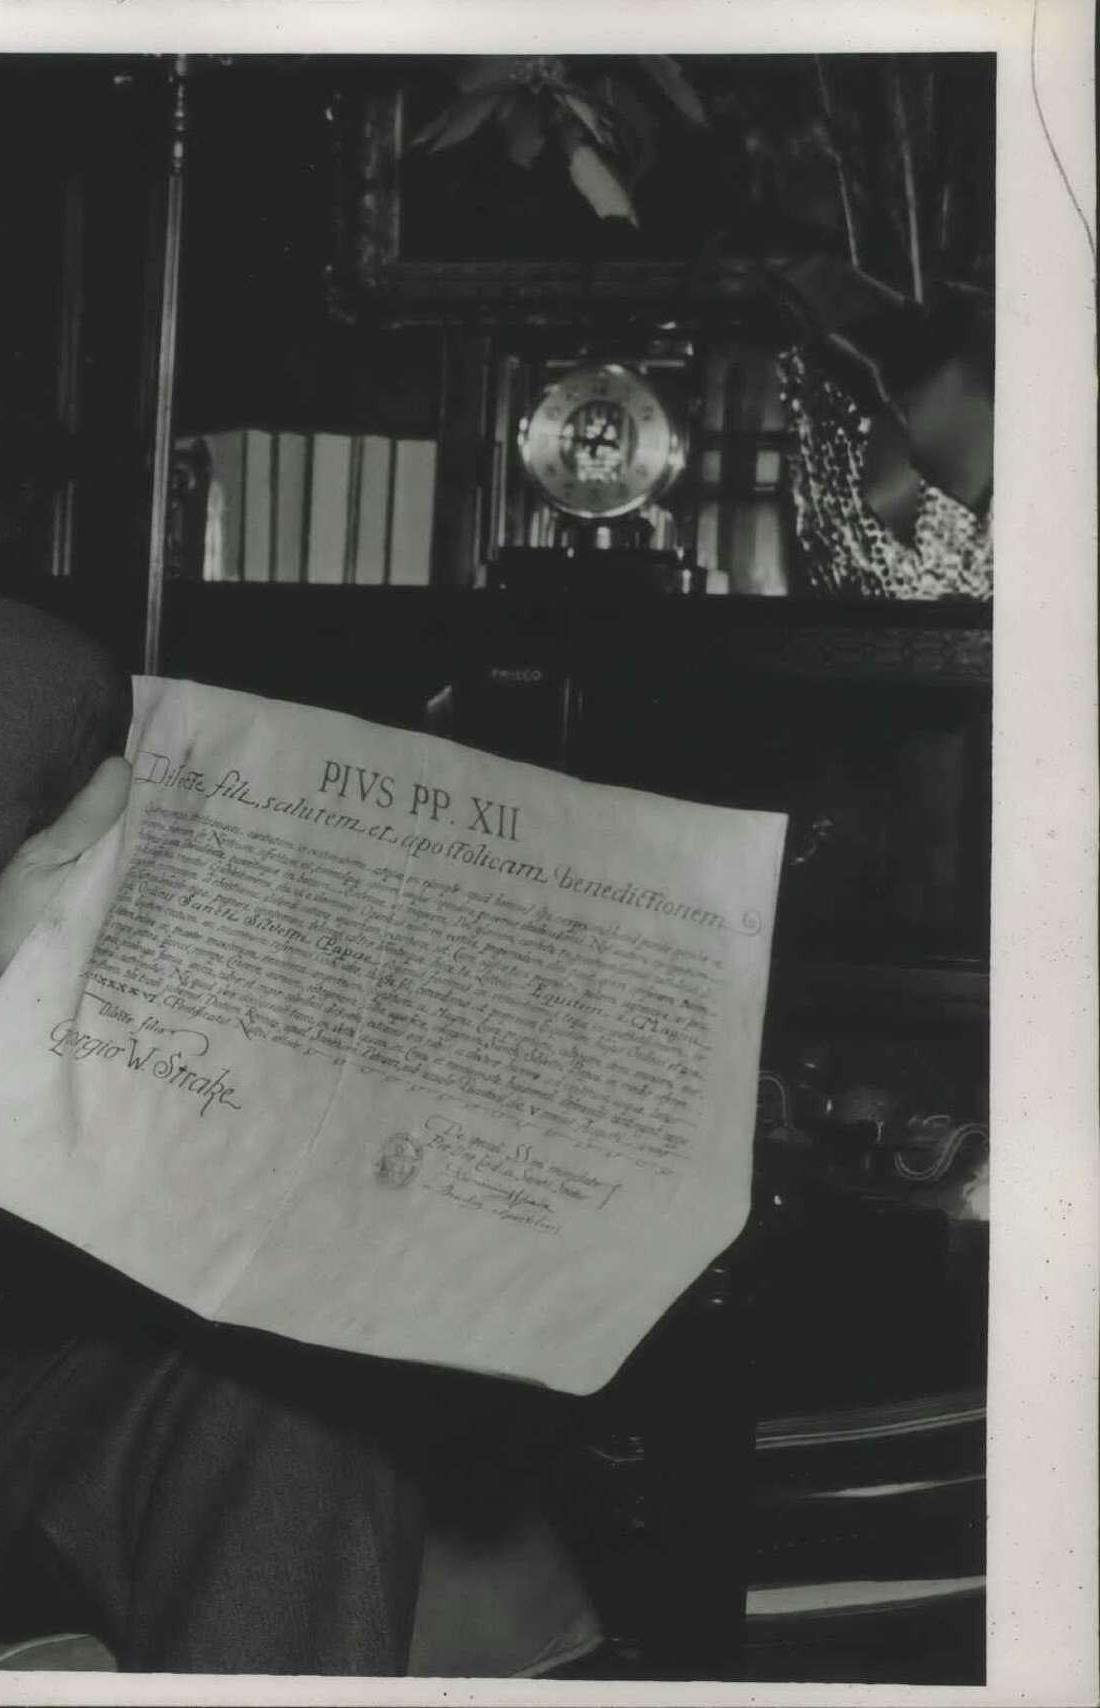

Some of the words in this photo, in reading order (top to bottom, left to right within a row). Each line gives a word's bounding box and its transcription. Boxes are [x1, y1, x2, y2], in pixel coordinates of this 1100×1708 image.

[261, 796, 366, 832] salutem
[318, 761, 395, 808] PIVS
[409, 784, 455, 824] PP.
[468, 797, 521, 841] XII
[152, 1051, 241, 1117] Strake
